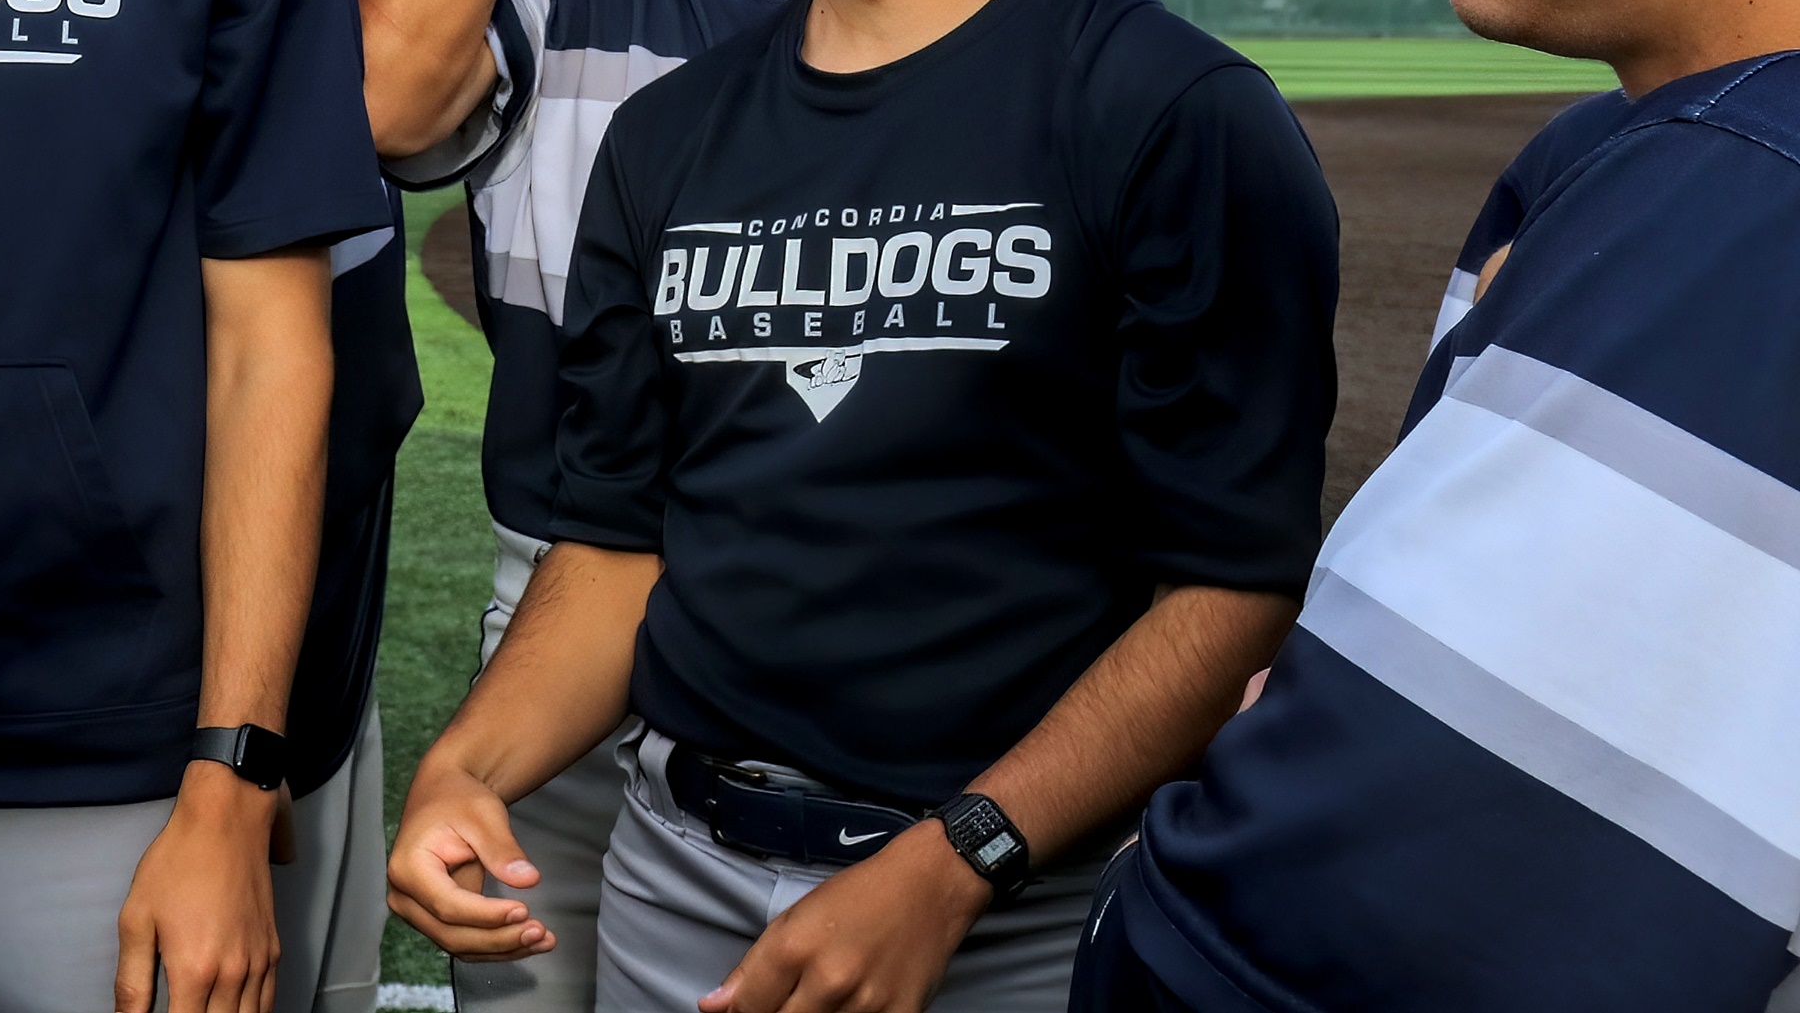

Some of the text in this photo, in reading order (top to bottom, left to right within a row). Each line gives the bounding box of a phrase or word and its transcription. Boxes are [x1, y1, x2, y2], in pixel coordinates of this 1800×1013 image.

[747, 202, 945, 237] CONCORDIA
[653, 224, 1053, 316] BULLDOGS
[670, 301, 1006, 344] BASEBALL
